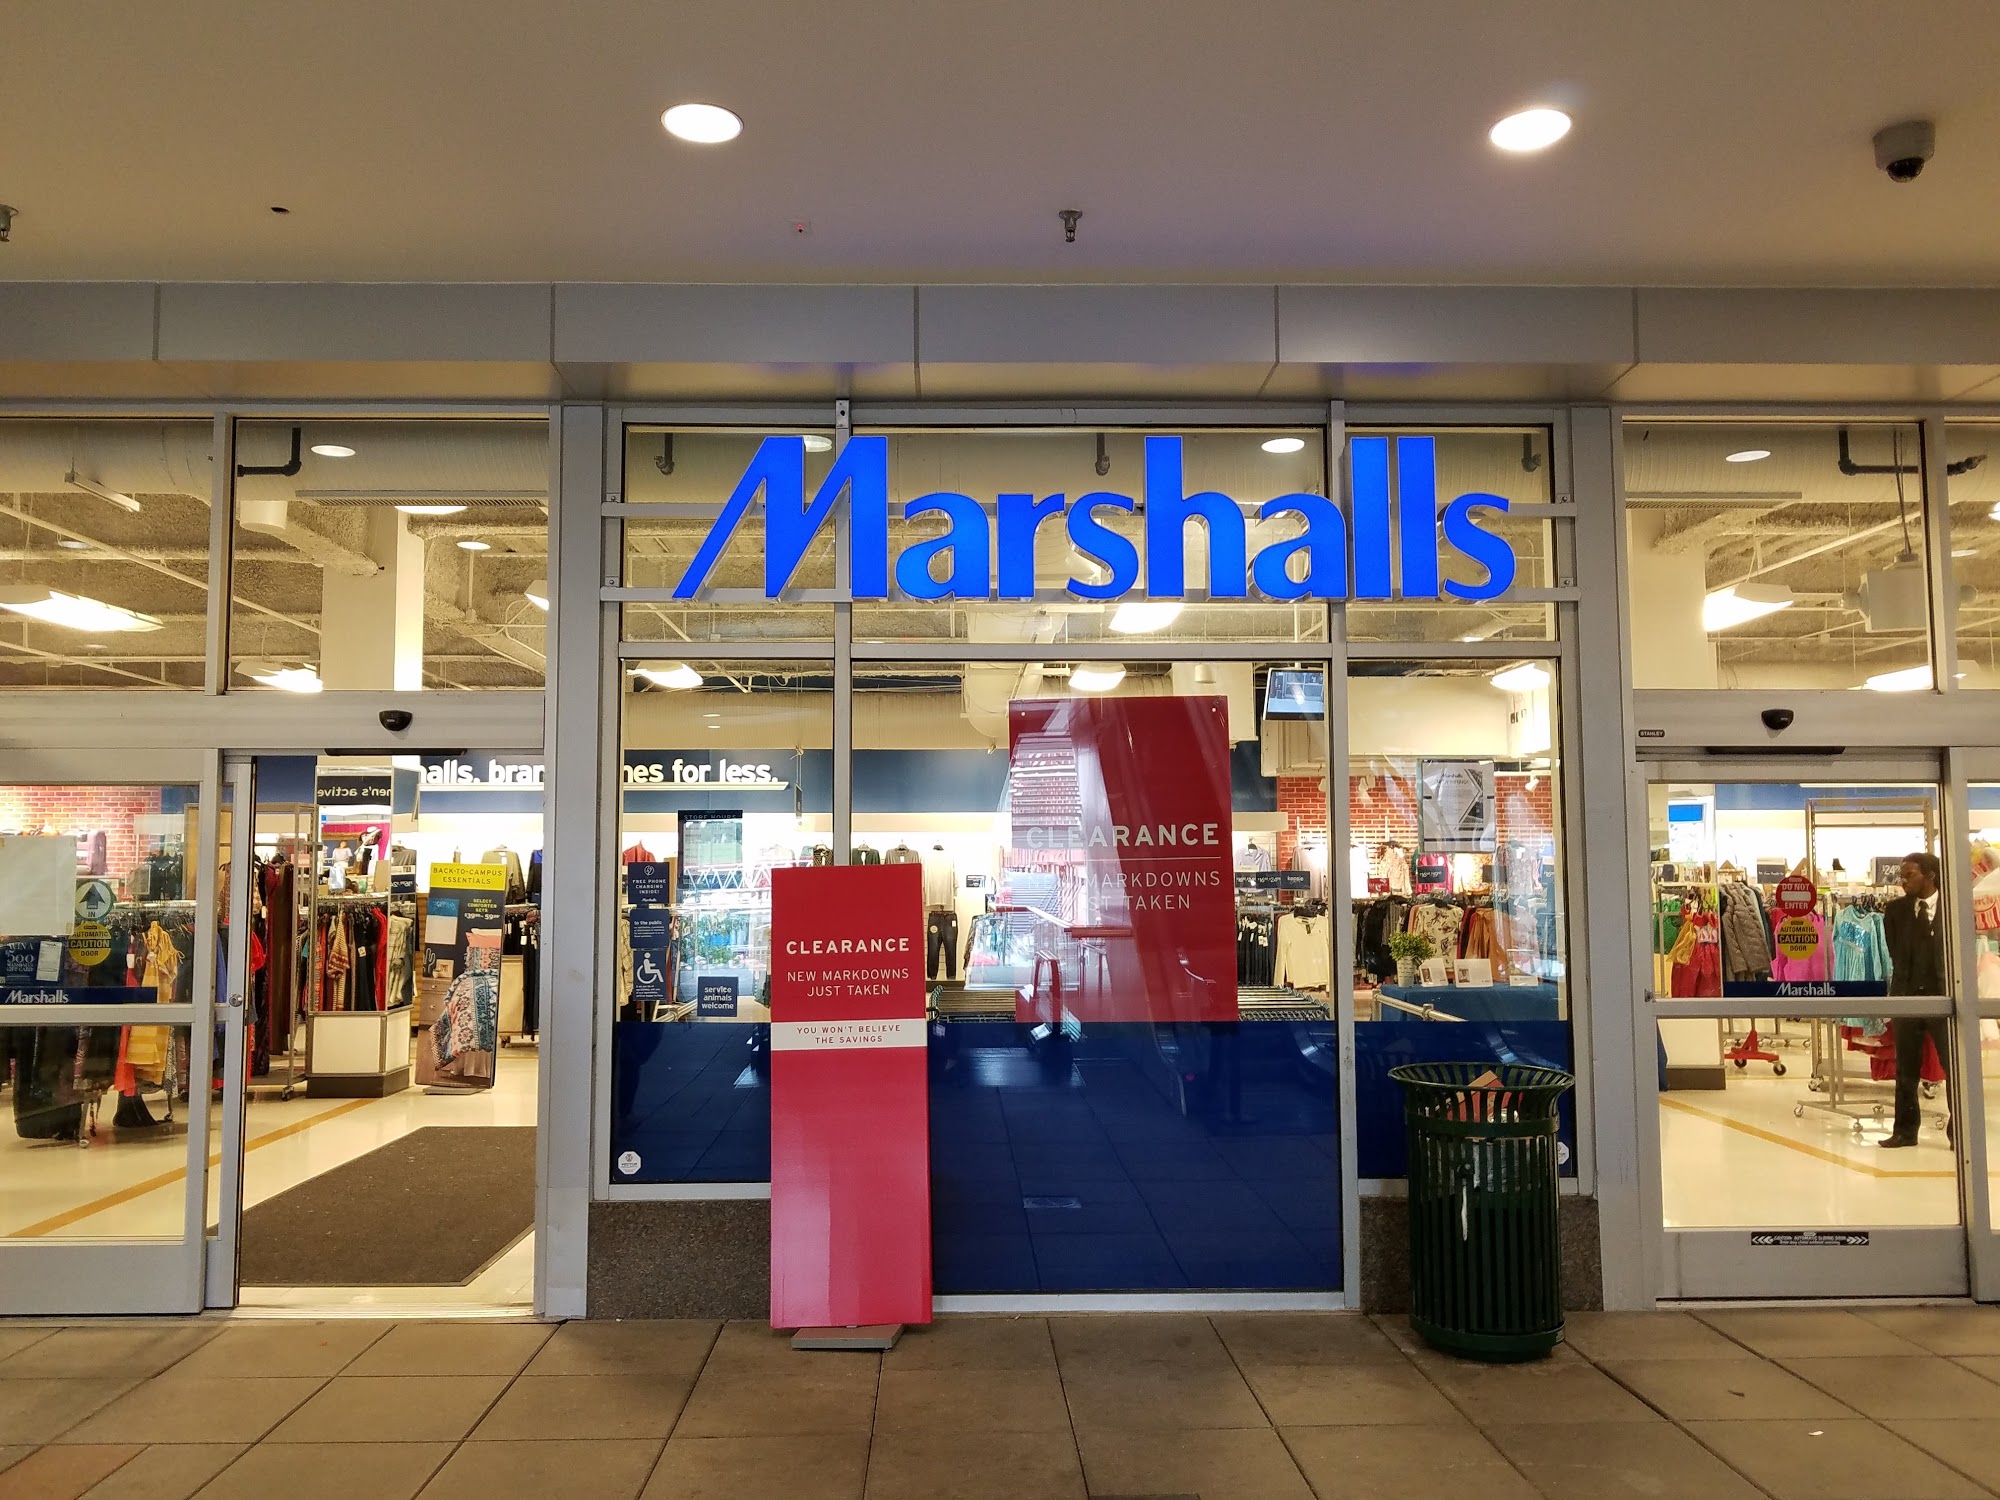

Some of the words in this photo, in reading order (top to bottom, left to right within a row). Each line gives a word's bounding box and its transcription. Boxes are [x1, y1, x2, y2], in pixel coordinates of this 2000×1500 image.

[672, 436, 1517, 602] Marshalls
[418, 759, 481, 783] alls.
[672, 759, 711, 783] for
[720, 759, 779, 783] less.
[1026, 823, 1219, 849] CLEARANCE
[433, 868, 502, 876] BACK-TO-CAMPUS
[1086, 871, 1220, 888] MARKDOWNS
[1122, 894, 1191, 910] TAKEN
[1785, 902, 1808, 910] ENTER
[71, 940, 110, 948] CAUTION
[1779, 935, 1817, 943] CAUTION
[786, 938, 909, 955] CLEARANCE
[787, 971, 817, 982] NEW
[822, 968, 909, 981] MARKDOWNS
[806, 985, 841, 997] JUST
[847, 984, 890, 996] TAKEN
[1775, 982, 1836, 996] Marshalls
[5, 990, 69, 1003] Marshalls
[701, 1002, 734, 1010] welcome
[822, 1026, 853, 1034] WON'T
[858, 1025, 901, 1033] BELIEVE
